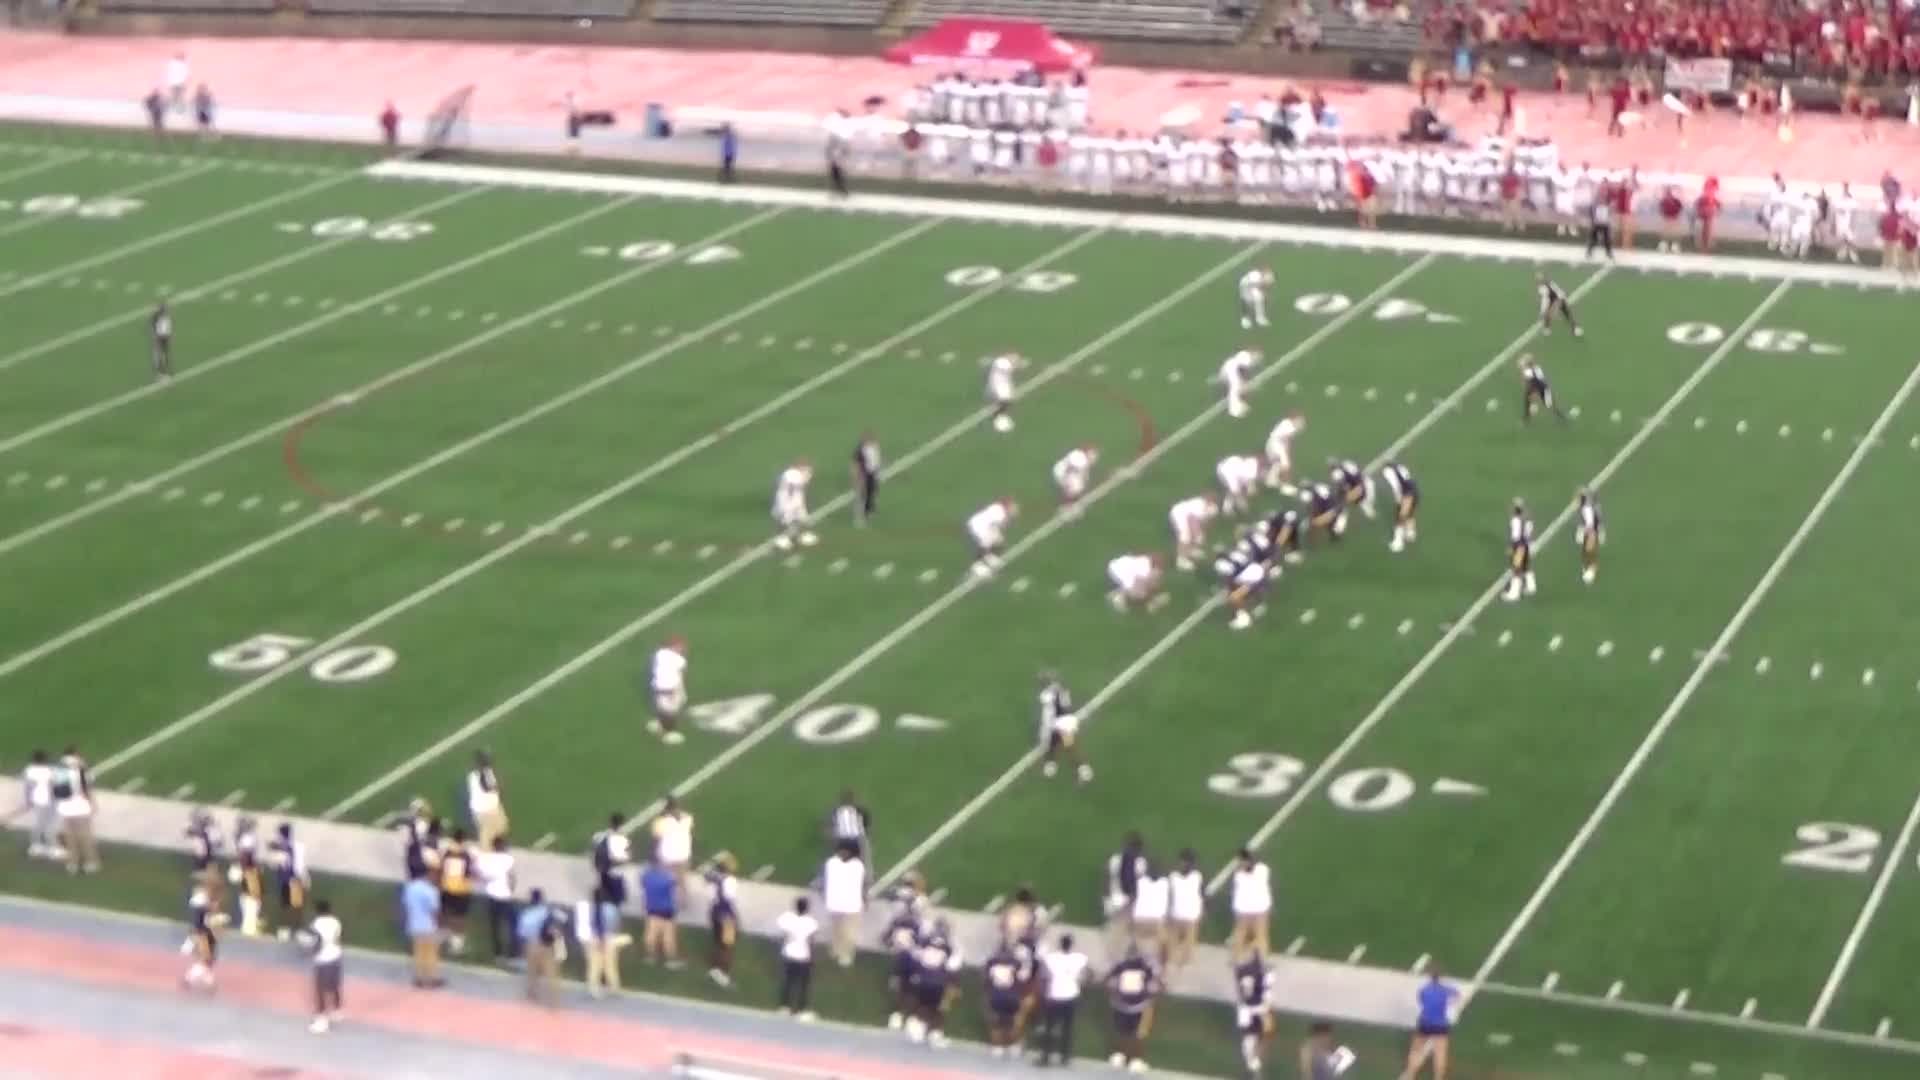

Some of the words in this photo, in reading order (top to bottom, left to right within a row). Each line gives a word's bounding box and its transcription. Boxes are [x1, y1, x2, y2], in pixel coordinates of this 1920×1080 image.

[945, 263, 1078, 292] 50
[208, 634, 399, 684] 50
[690, 694, 882, 745] 40
[1207, 753, 1415, 812] 30
[1780, 822, 1920, 873] 2
